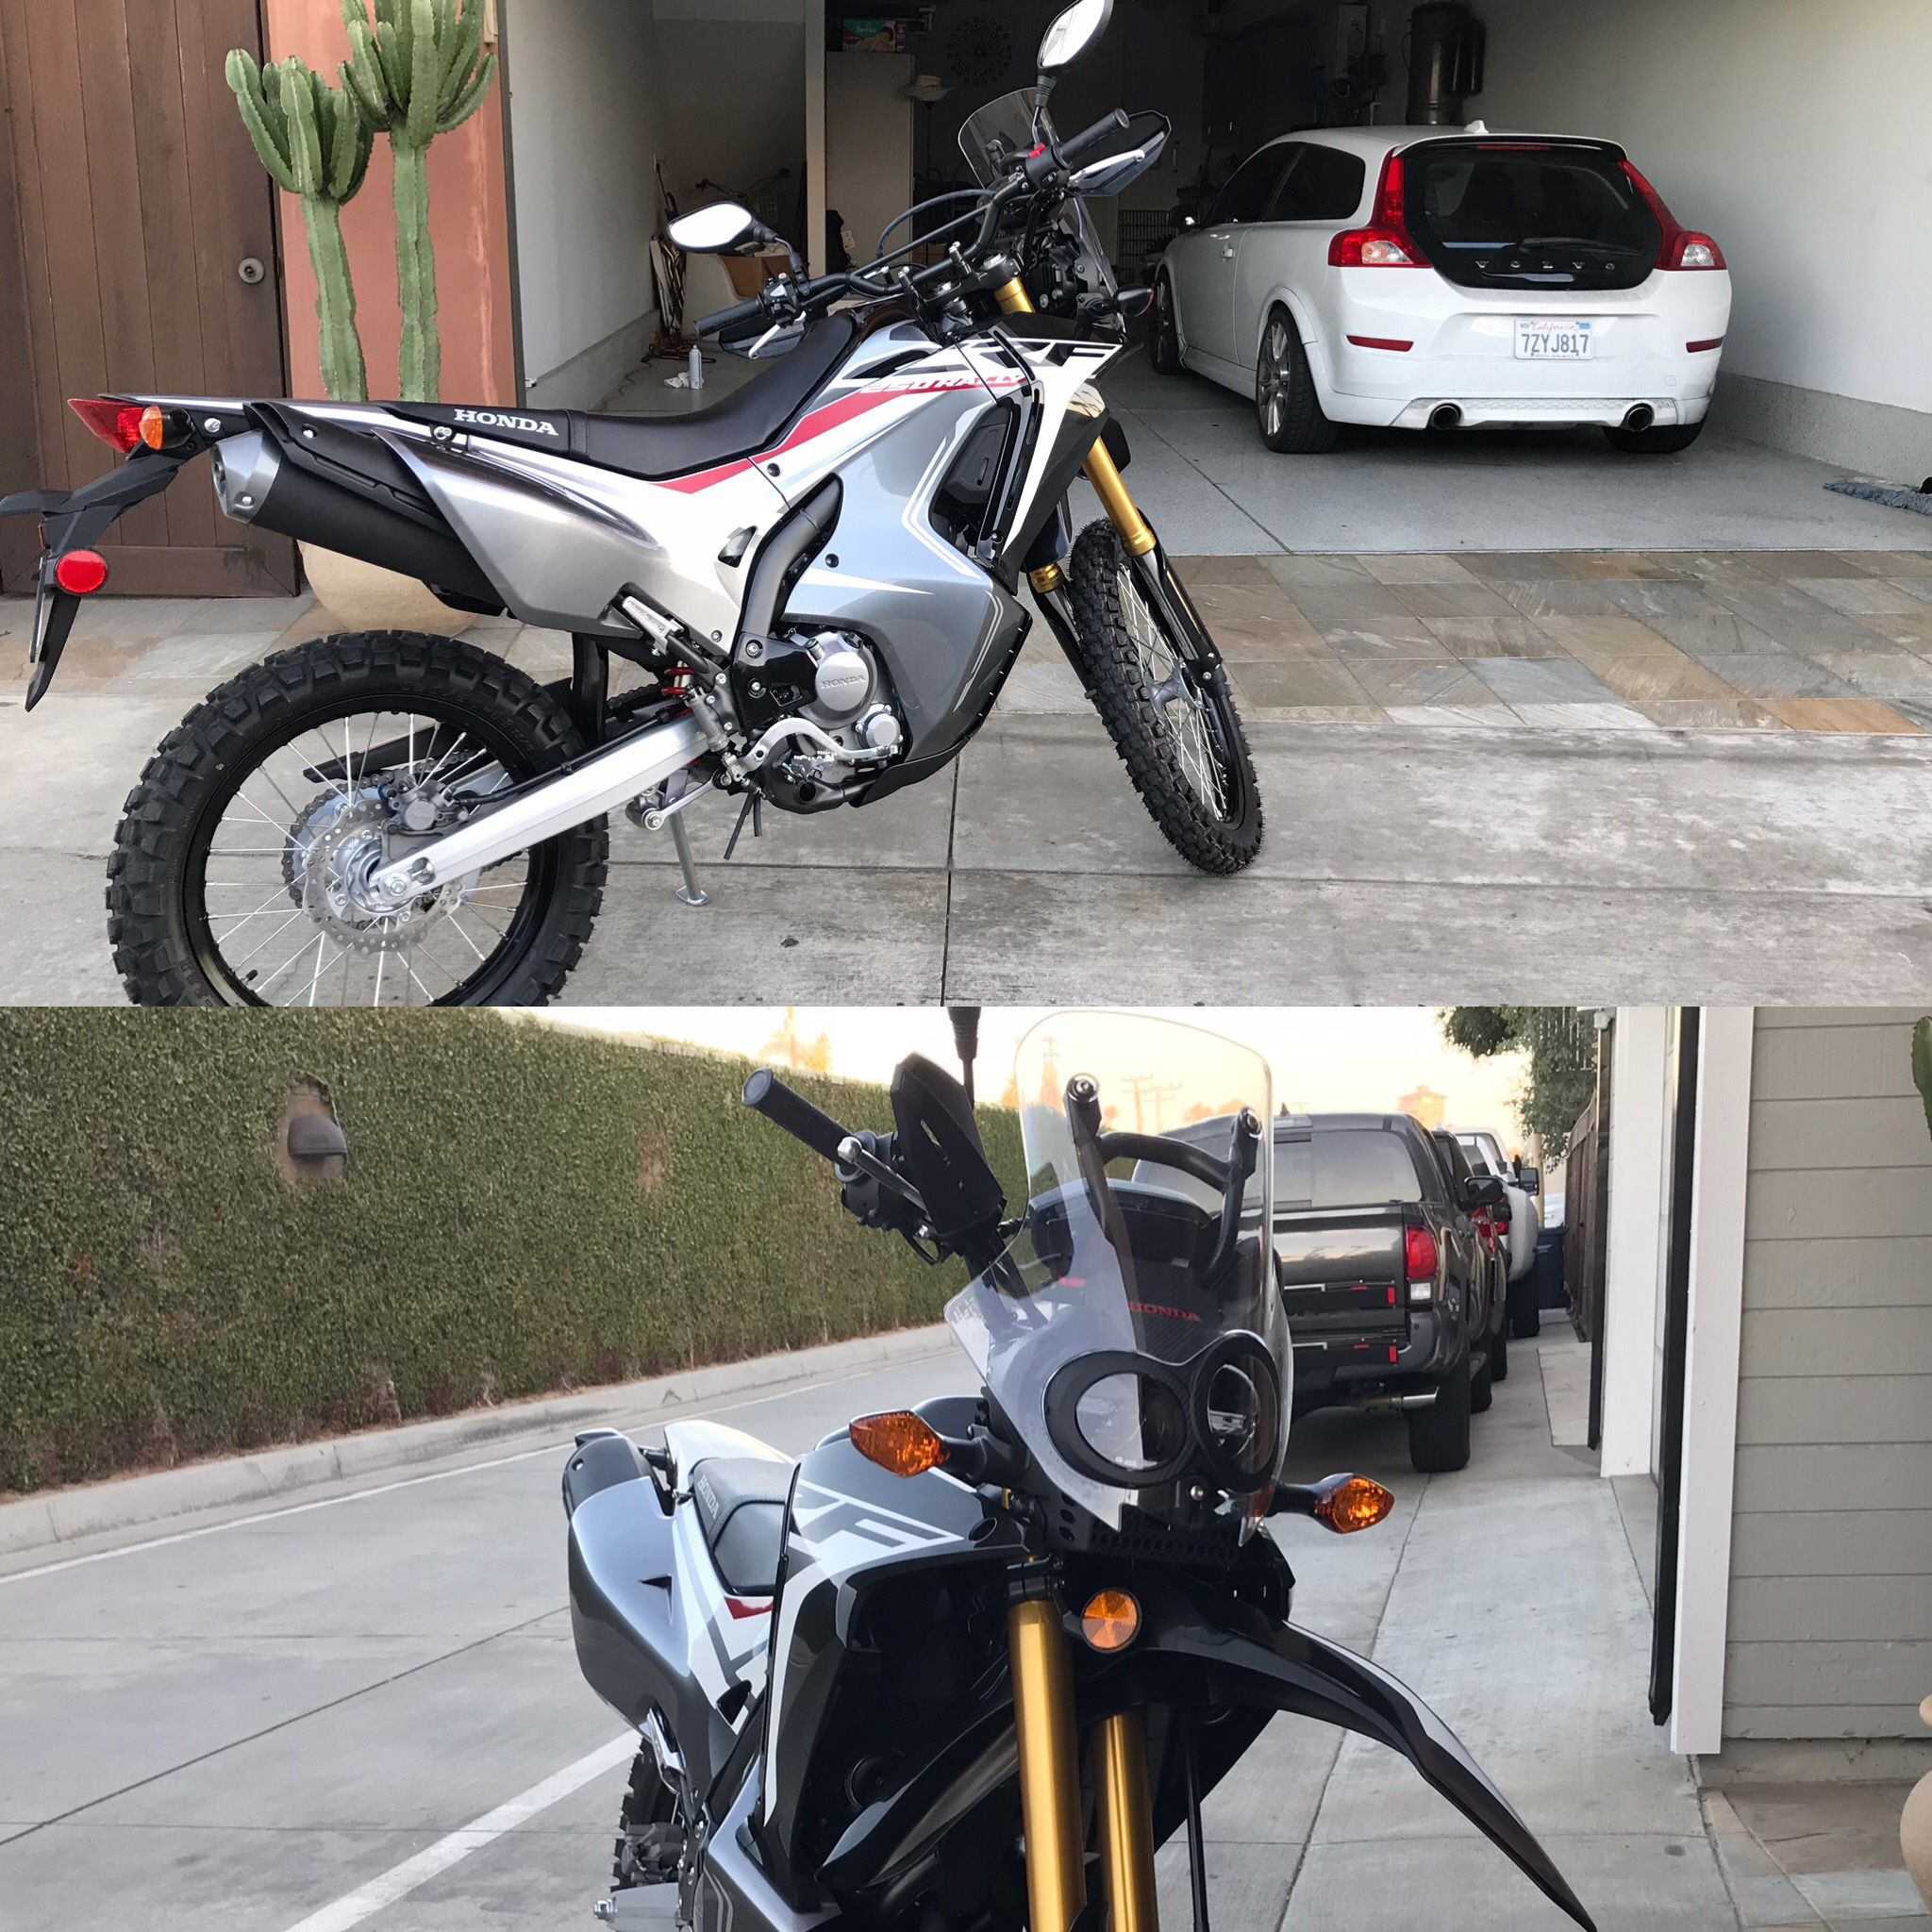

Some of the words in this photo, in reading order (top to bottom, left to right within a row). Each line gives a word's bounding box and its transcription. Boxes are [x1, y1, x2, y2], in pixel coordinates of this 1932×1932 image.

[1475, 260, 1615, 271] VOLVO
[1521, 333, 1589, 353] 7ZYJ817
[454, 408, 558, 436] HONDA
[821, 675, 866, 690] HONDA
[1129, 1301, 1204, 1322] HONDA
[698, 1473, 720, 1521] HONDA
